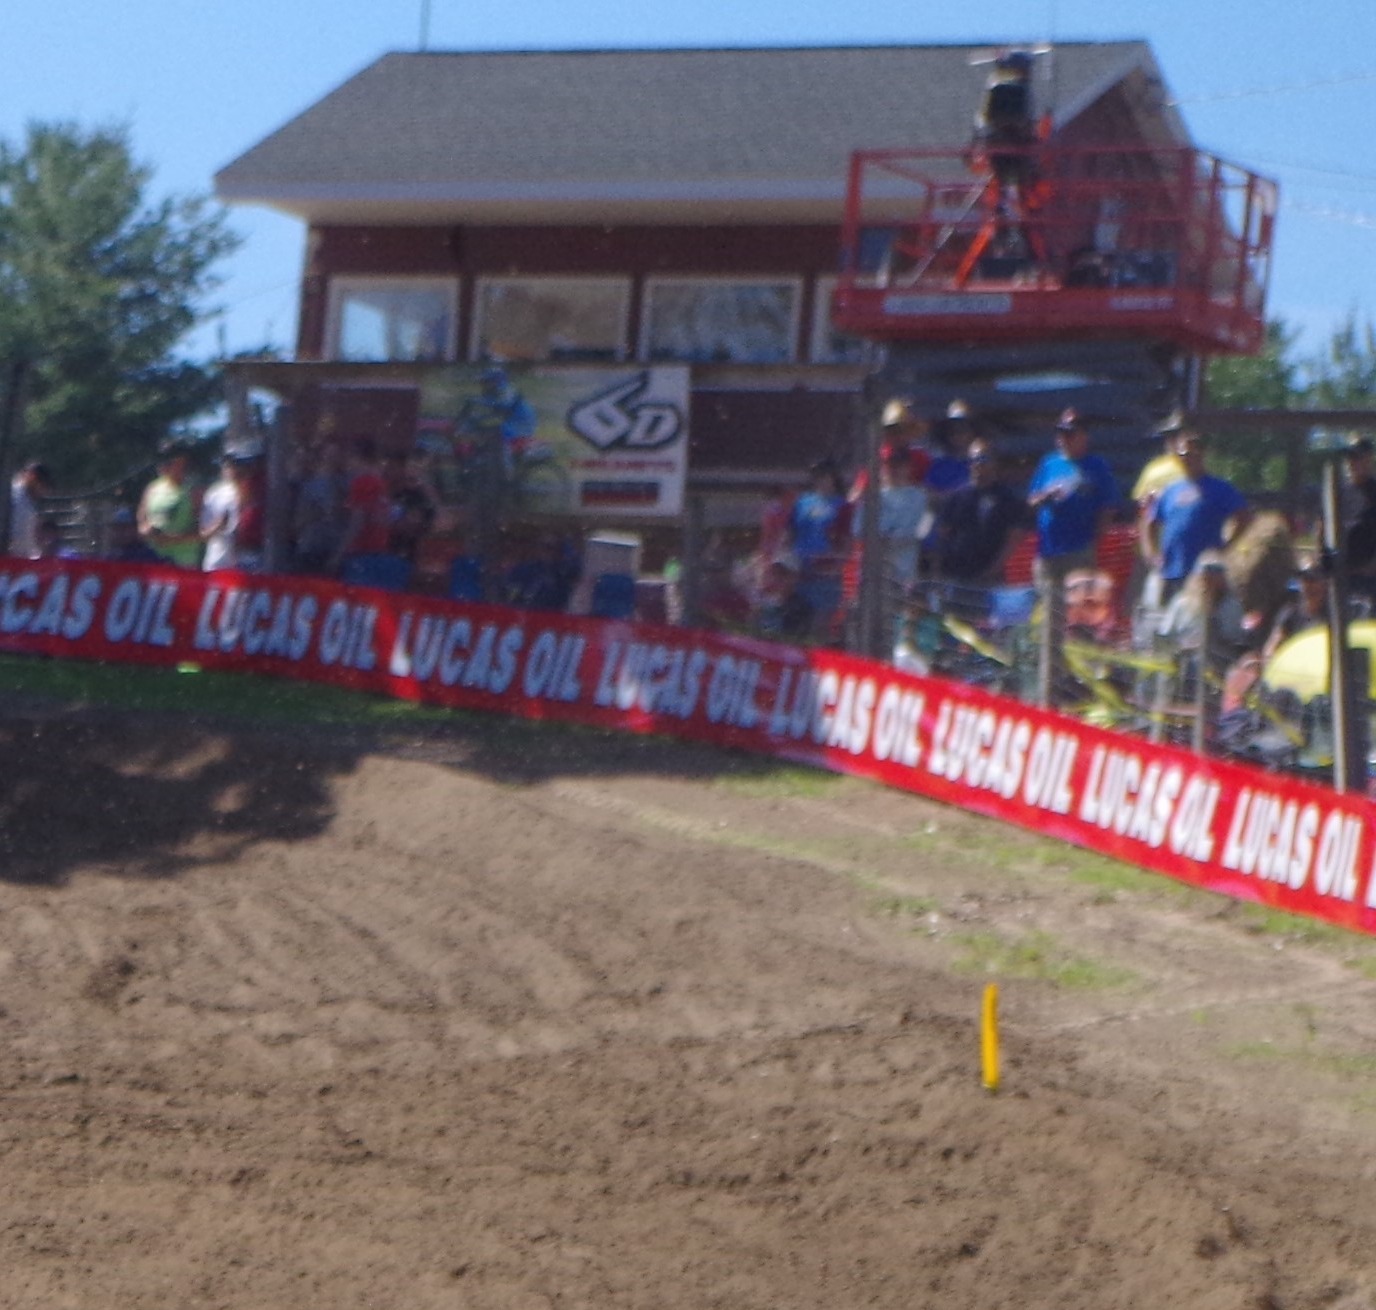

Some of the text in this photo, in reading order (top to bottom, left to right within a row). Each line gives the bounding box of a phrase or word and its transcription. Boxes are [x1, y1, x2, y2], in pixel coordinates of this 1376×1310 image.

[103, 576, 178, 646] OIL
[194, 585, 378, 670] LUCAS OIL
[389, 611, 584, 700] LUCAS OIL
[594, 640, 763, 729] LUCAS OIL
[769, 666, 926, 768] LUCAS OIL
[927, 699, 1079, 815] LUCAS OIL
[1079, 743, 1222, 863] LUCAS OIL
[1221, 785, 1320, 890] LUCAS
[1314, 807, 1363, 901] OIL
